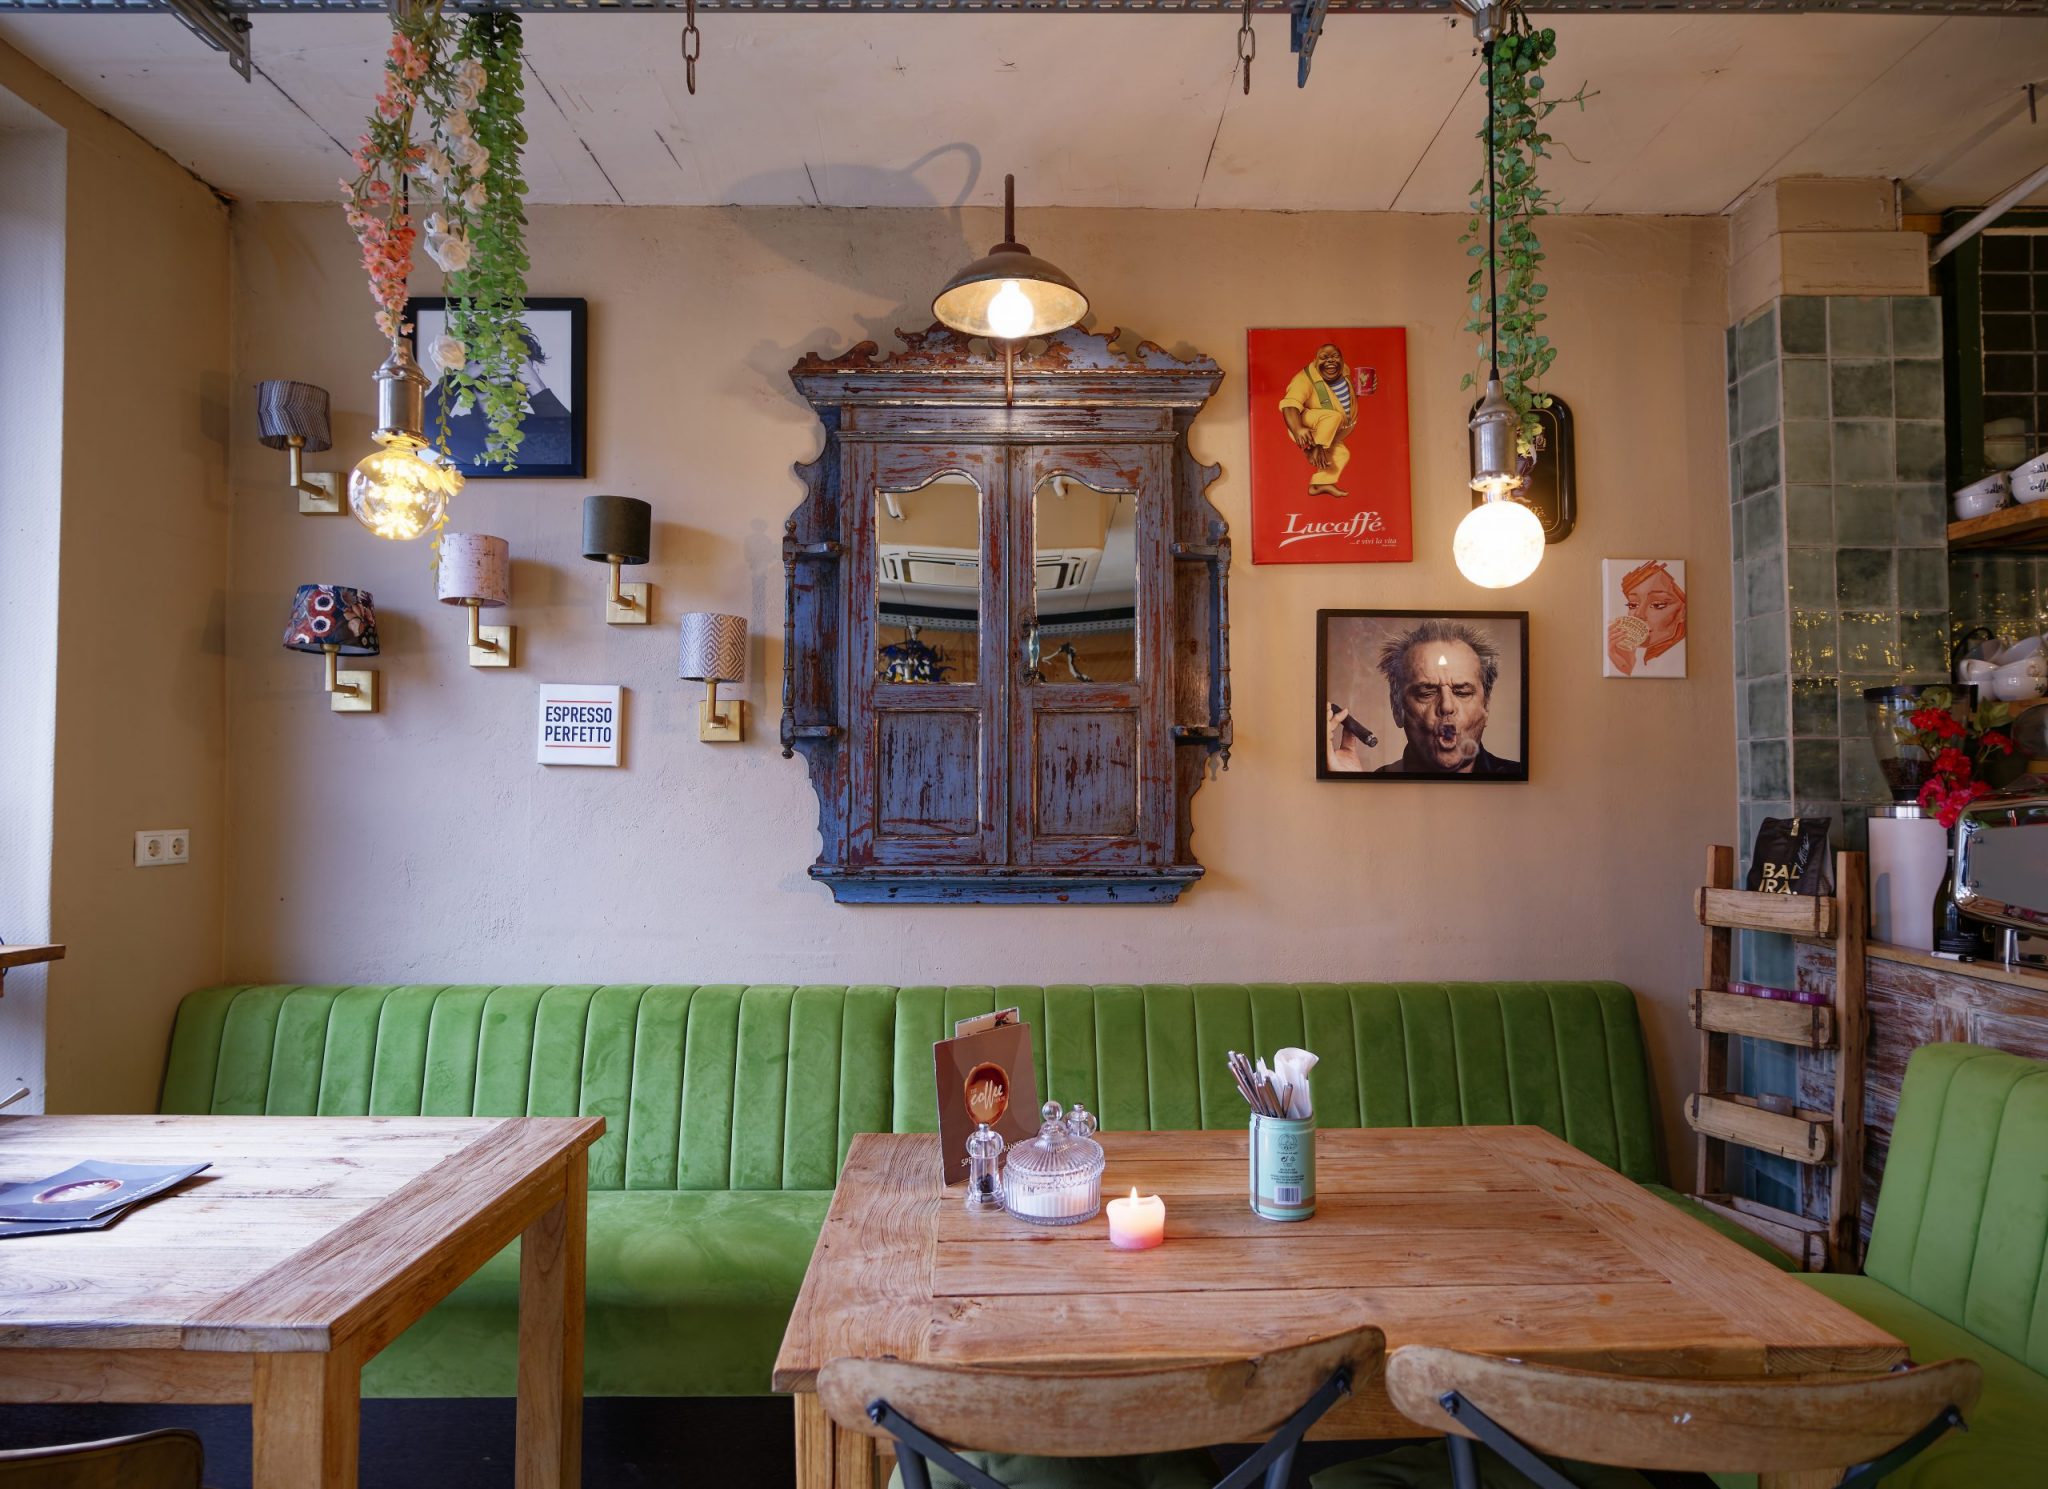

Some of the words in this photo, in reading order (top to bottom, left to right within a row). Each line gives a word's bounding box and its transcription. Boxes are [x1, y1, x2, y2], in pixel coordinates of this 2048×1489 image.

[1280, 511, 1384, 539] Lucaffé
[1375, 537, 1382, 545] la
[1384, 537, 1397, 545] vita
[545, 706, 612, 723] ESPRESSO
[545, 725, 611, 743] PERFETTO
[1763, 862, 1800, 879] BAL
[971, 1080, 1003, 1110] coffee
